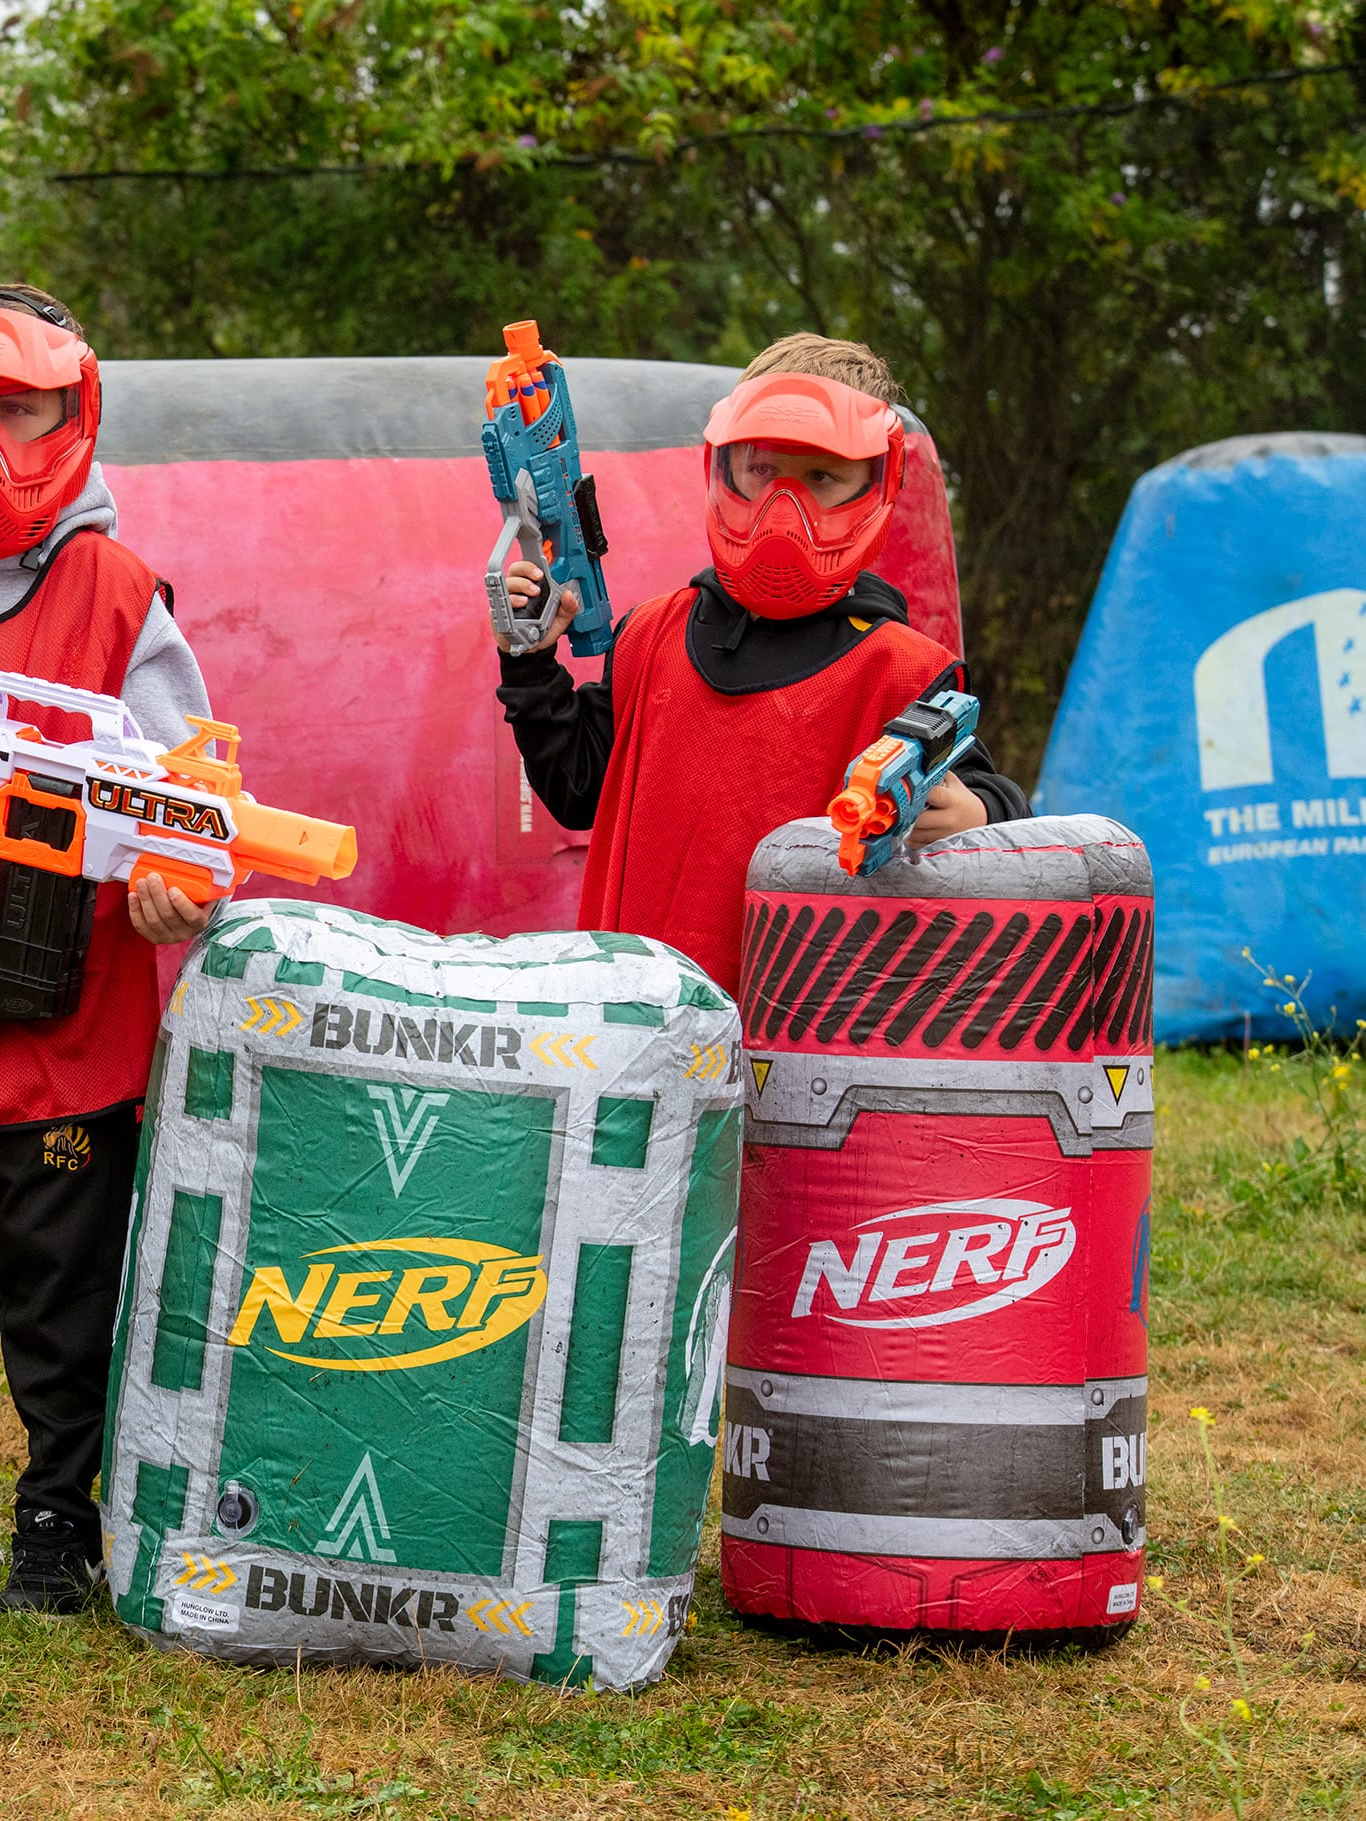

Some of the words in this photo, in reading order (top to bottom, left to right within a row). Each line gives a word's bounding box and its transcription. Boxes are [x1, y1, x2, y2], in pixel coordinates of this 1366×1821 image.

[90, 779, 228, 839] ULTRA
[1204, 803, 1281, 836] THE
[1208, 838, 1328, 866] EUROPEAN
[1333, 835, 1366, 855] PA
[310, 1002, 522, 1070] BUNKR
[43, 1151, 79, 1171] RFC
[791, 1206, 1072, 1319] NERF
[227, 1253, 545, 1346] NERF
[180, 1609, 199, 1620] MADE
[207, 1616, 230, 1625] CHINA
[181, 1601, 214, 1615] HUNGLOW
[245, 1564, 460, 1633] BUNKR
